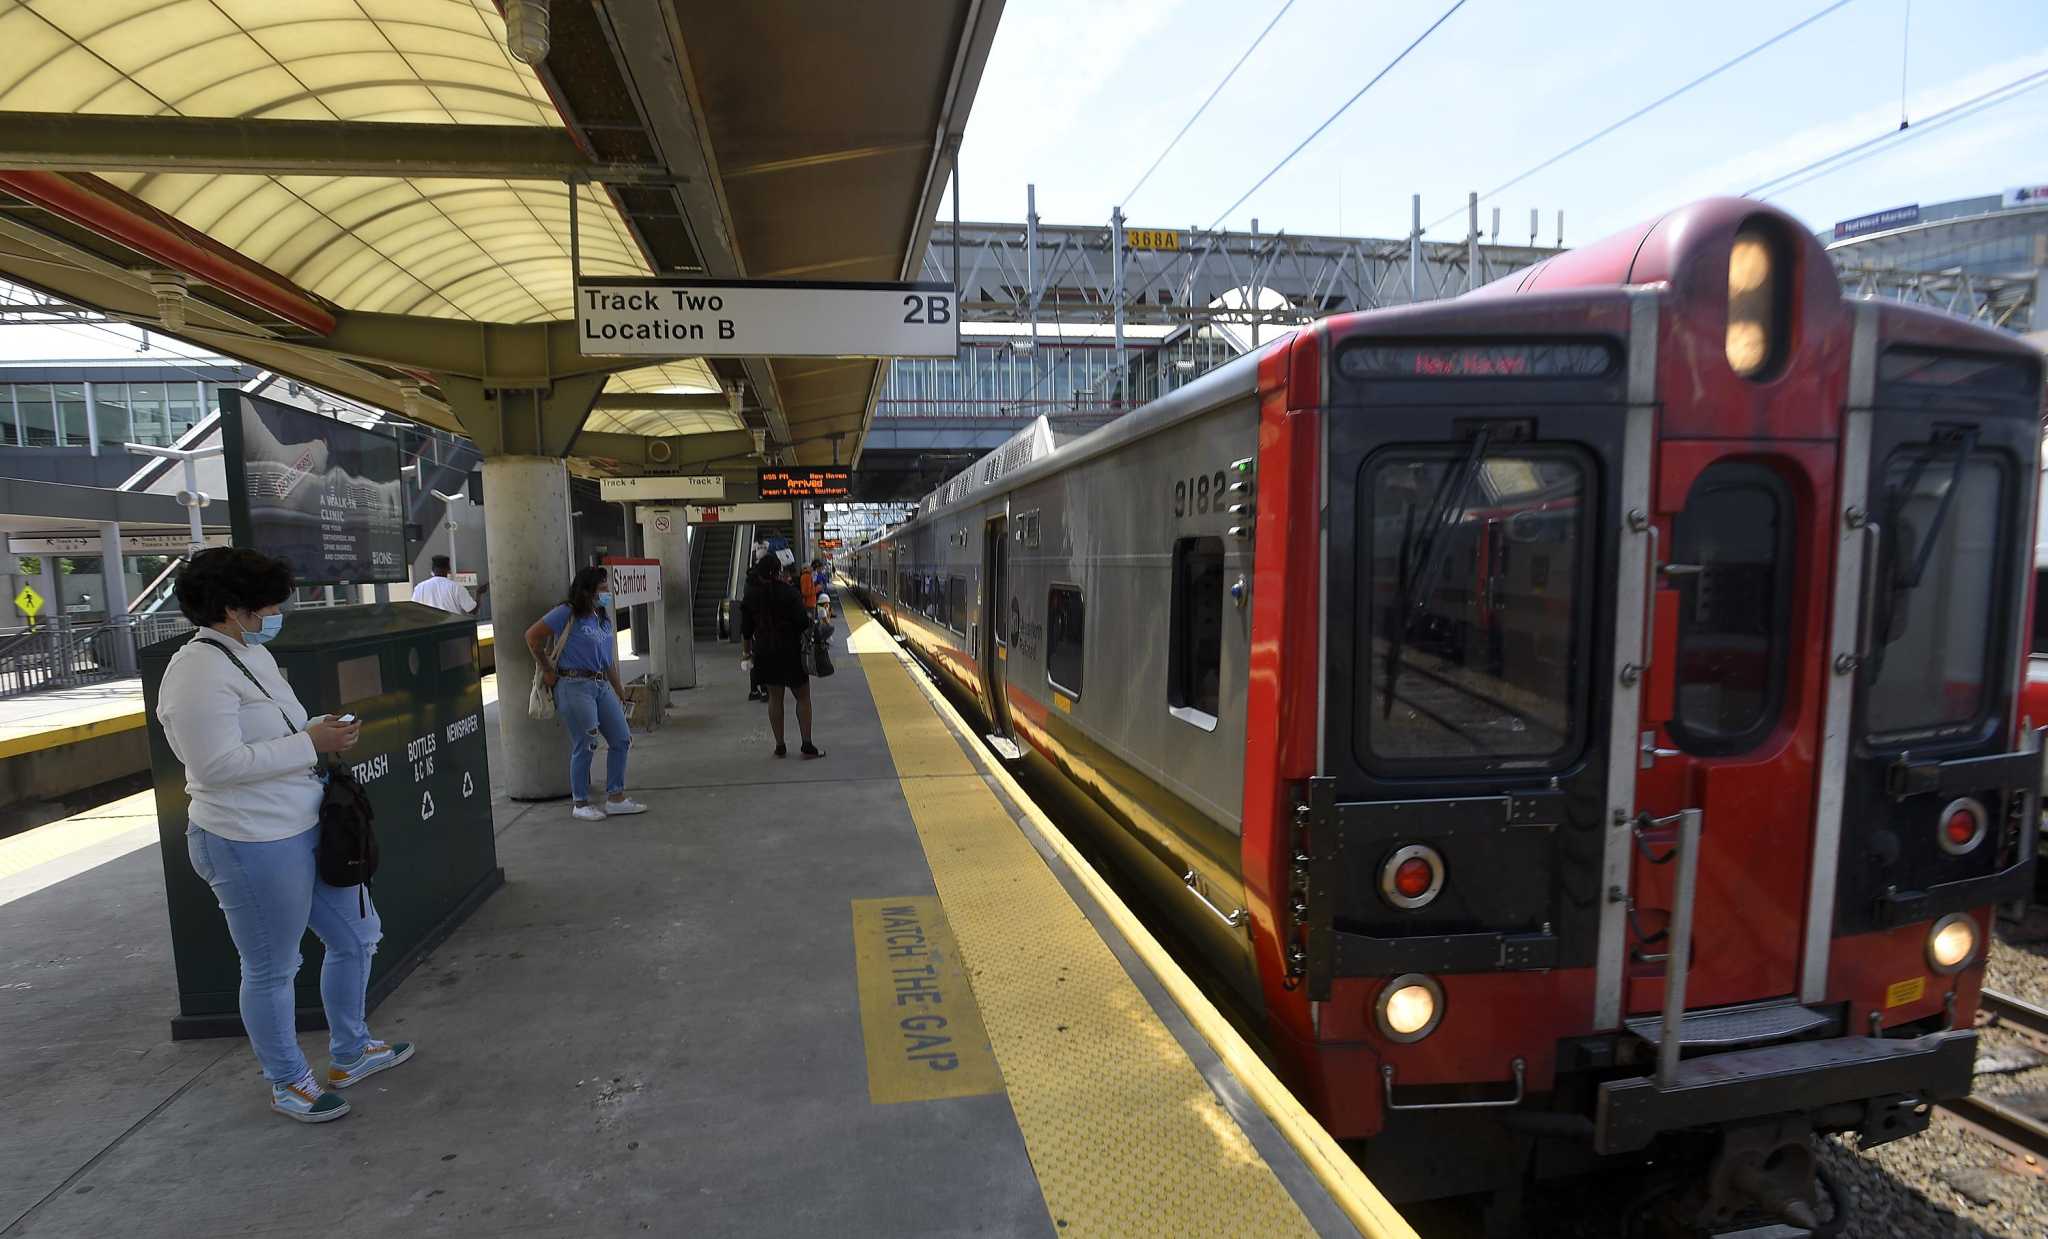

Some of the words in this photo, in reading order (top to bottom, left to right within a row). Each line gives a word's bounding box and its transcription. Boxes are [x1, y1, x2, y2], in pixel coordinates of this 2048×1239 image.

[1130, 230, 1174, 248] 368A
[585, 290, 659, 311] Track
[672, 290, 724, 311] Two
[903, 295, 951, 325] 2B
[585, 319, 704, 340] Location
[718, 319, 735, 340] B
[788, 480, 823, 488] Arrived
[1175, 471, 1227, 518] 9182
[320, 509, 345, 522] CLINIC
[613, 568, 647, 595] Stamford
[446, 714, 479, 743] NEWSPAPER
[407, 733, 437, 763] BOTTLES
[352, 753, 389, 785] TRASH
[881, 905, 928, 958] WATCH
[892, 964, 943, 1006] THE
[900, 1015, 960, 1072] GAP
